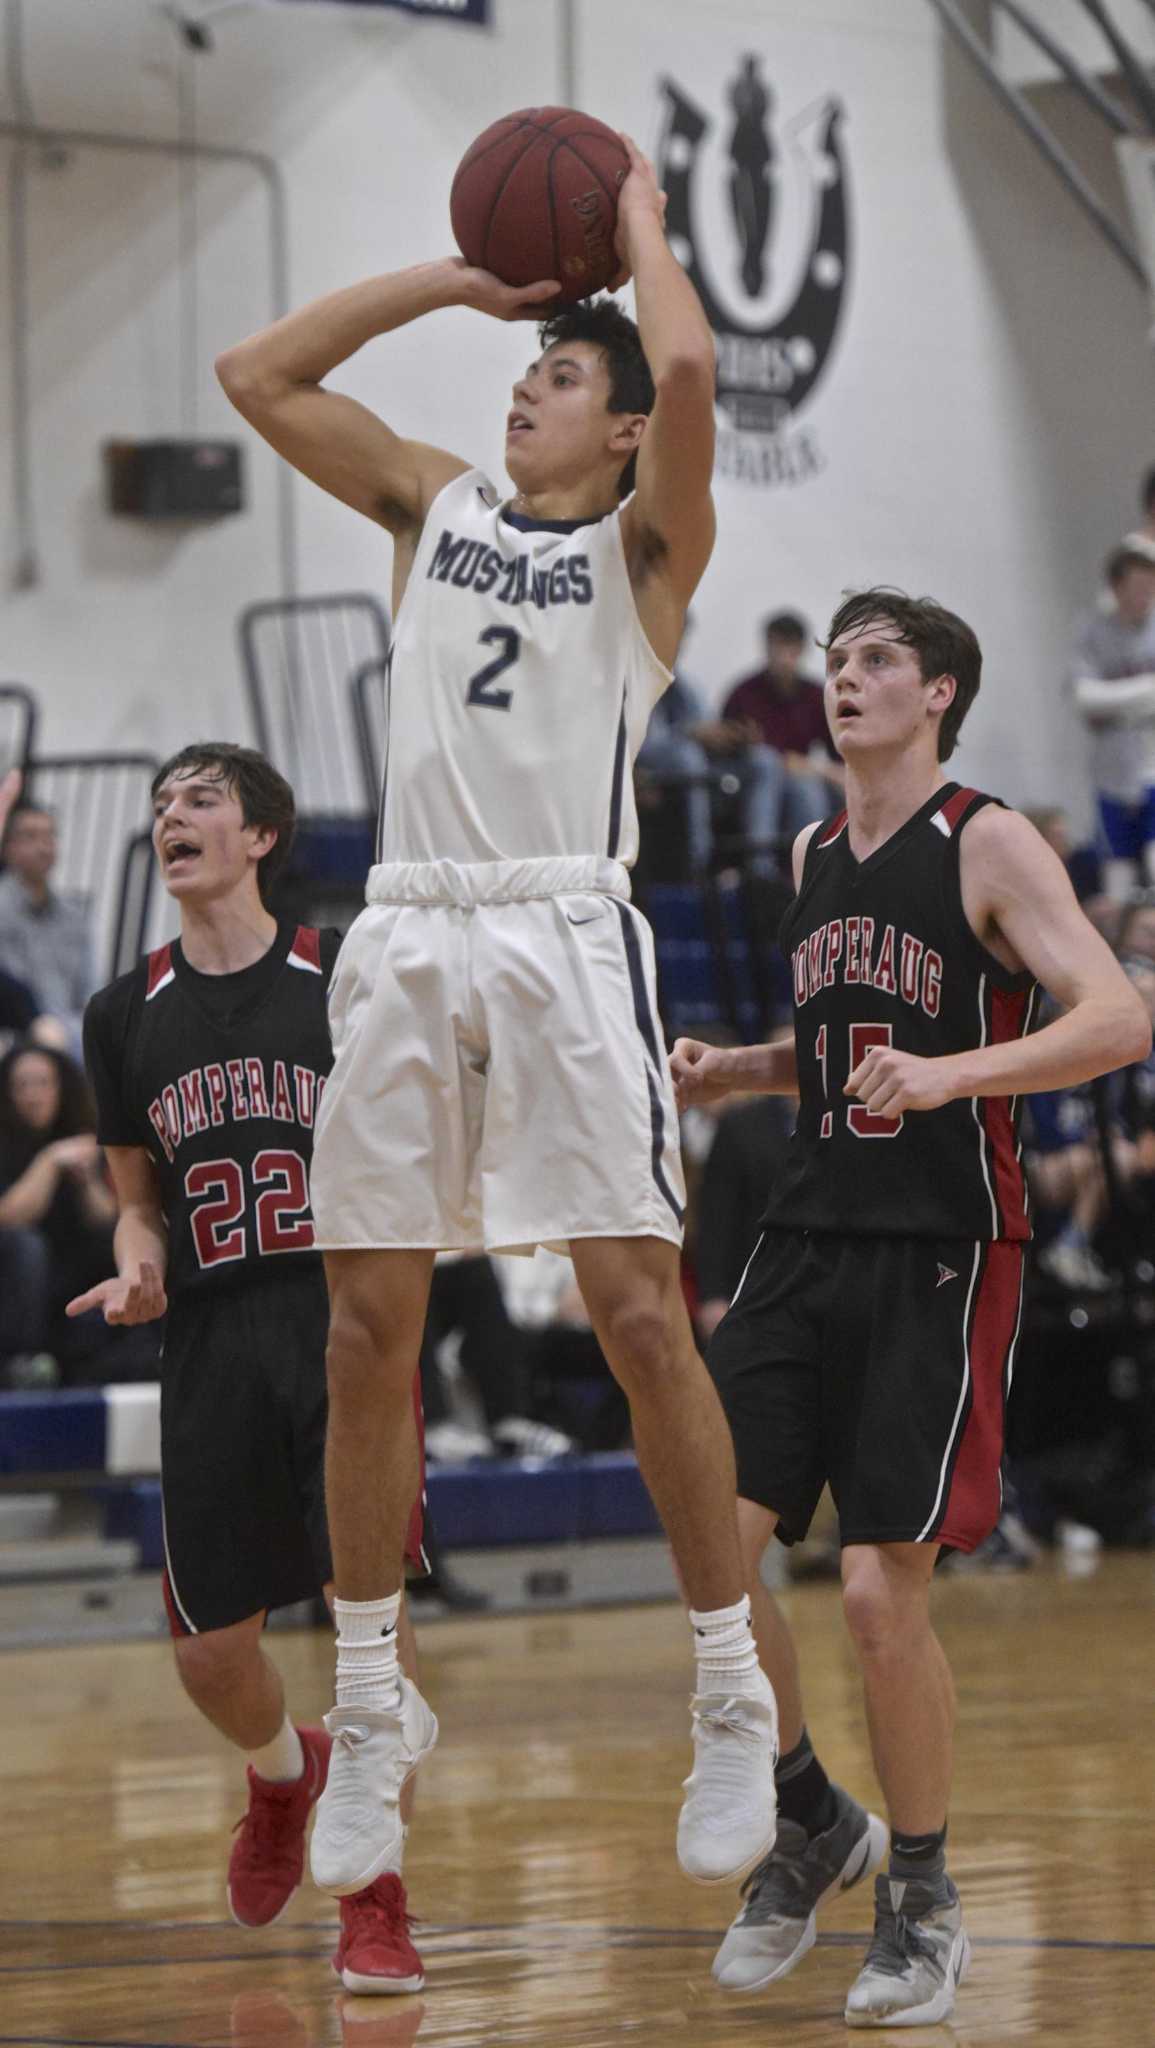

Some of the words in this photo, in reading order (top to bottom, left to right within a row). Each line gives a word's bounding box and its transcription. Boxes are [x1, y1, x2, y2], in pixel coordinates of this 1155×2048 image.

[426, 529, 594, 610] MUSTANGS
[465, 623, 521, 712] 2
[791, 916, 943, 1019] OMPERAUG
[184, 1149, 316, 1269] 22
